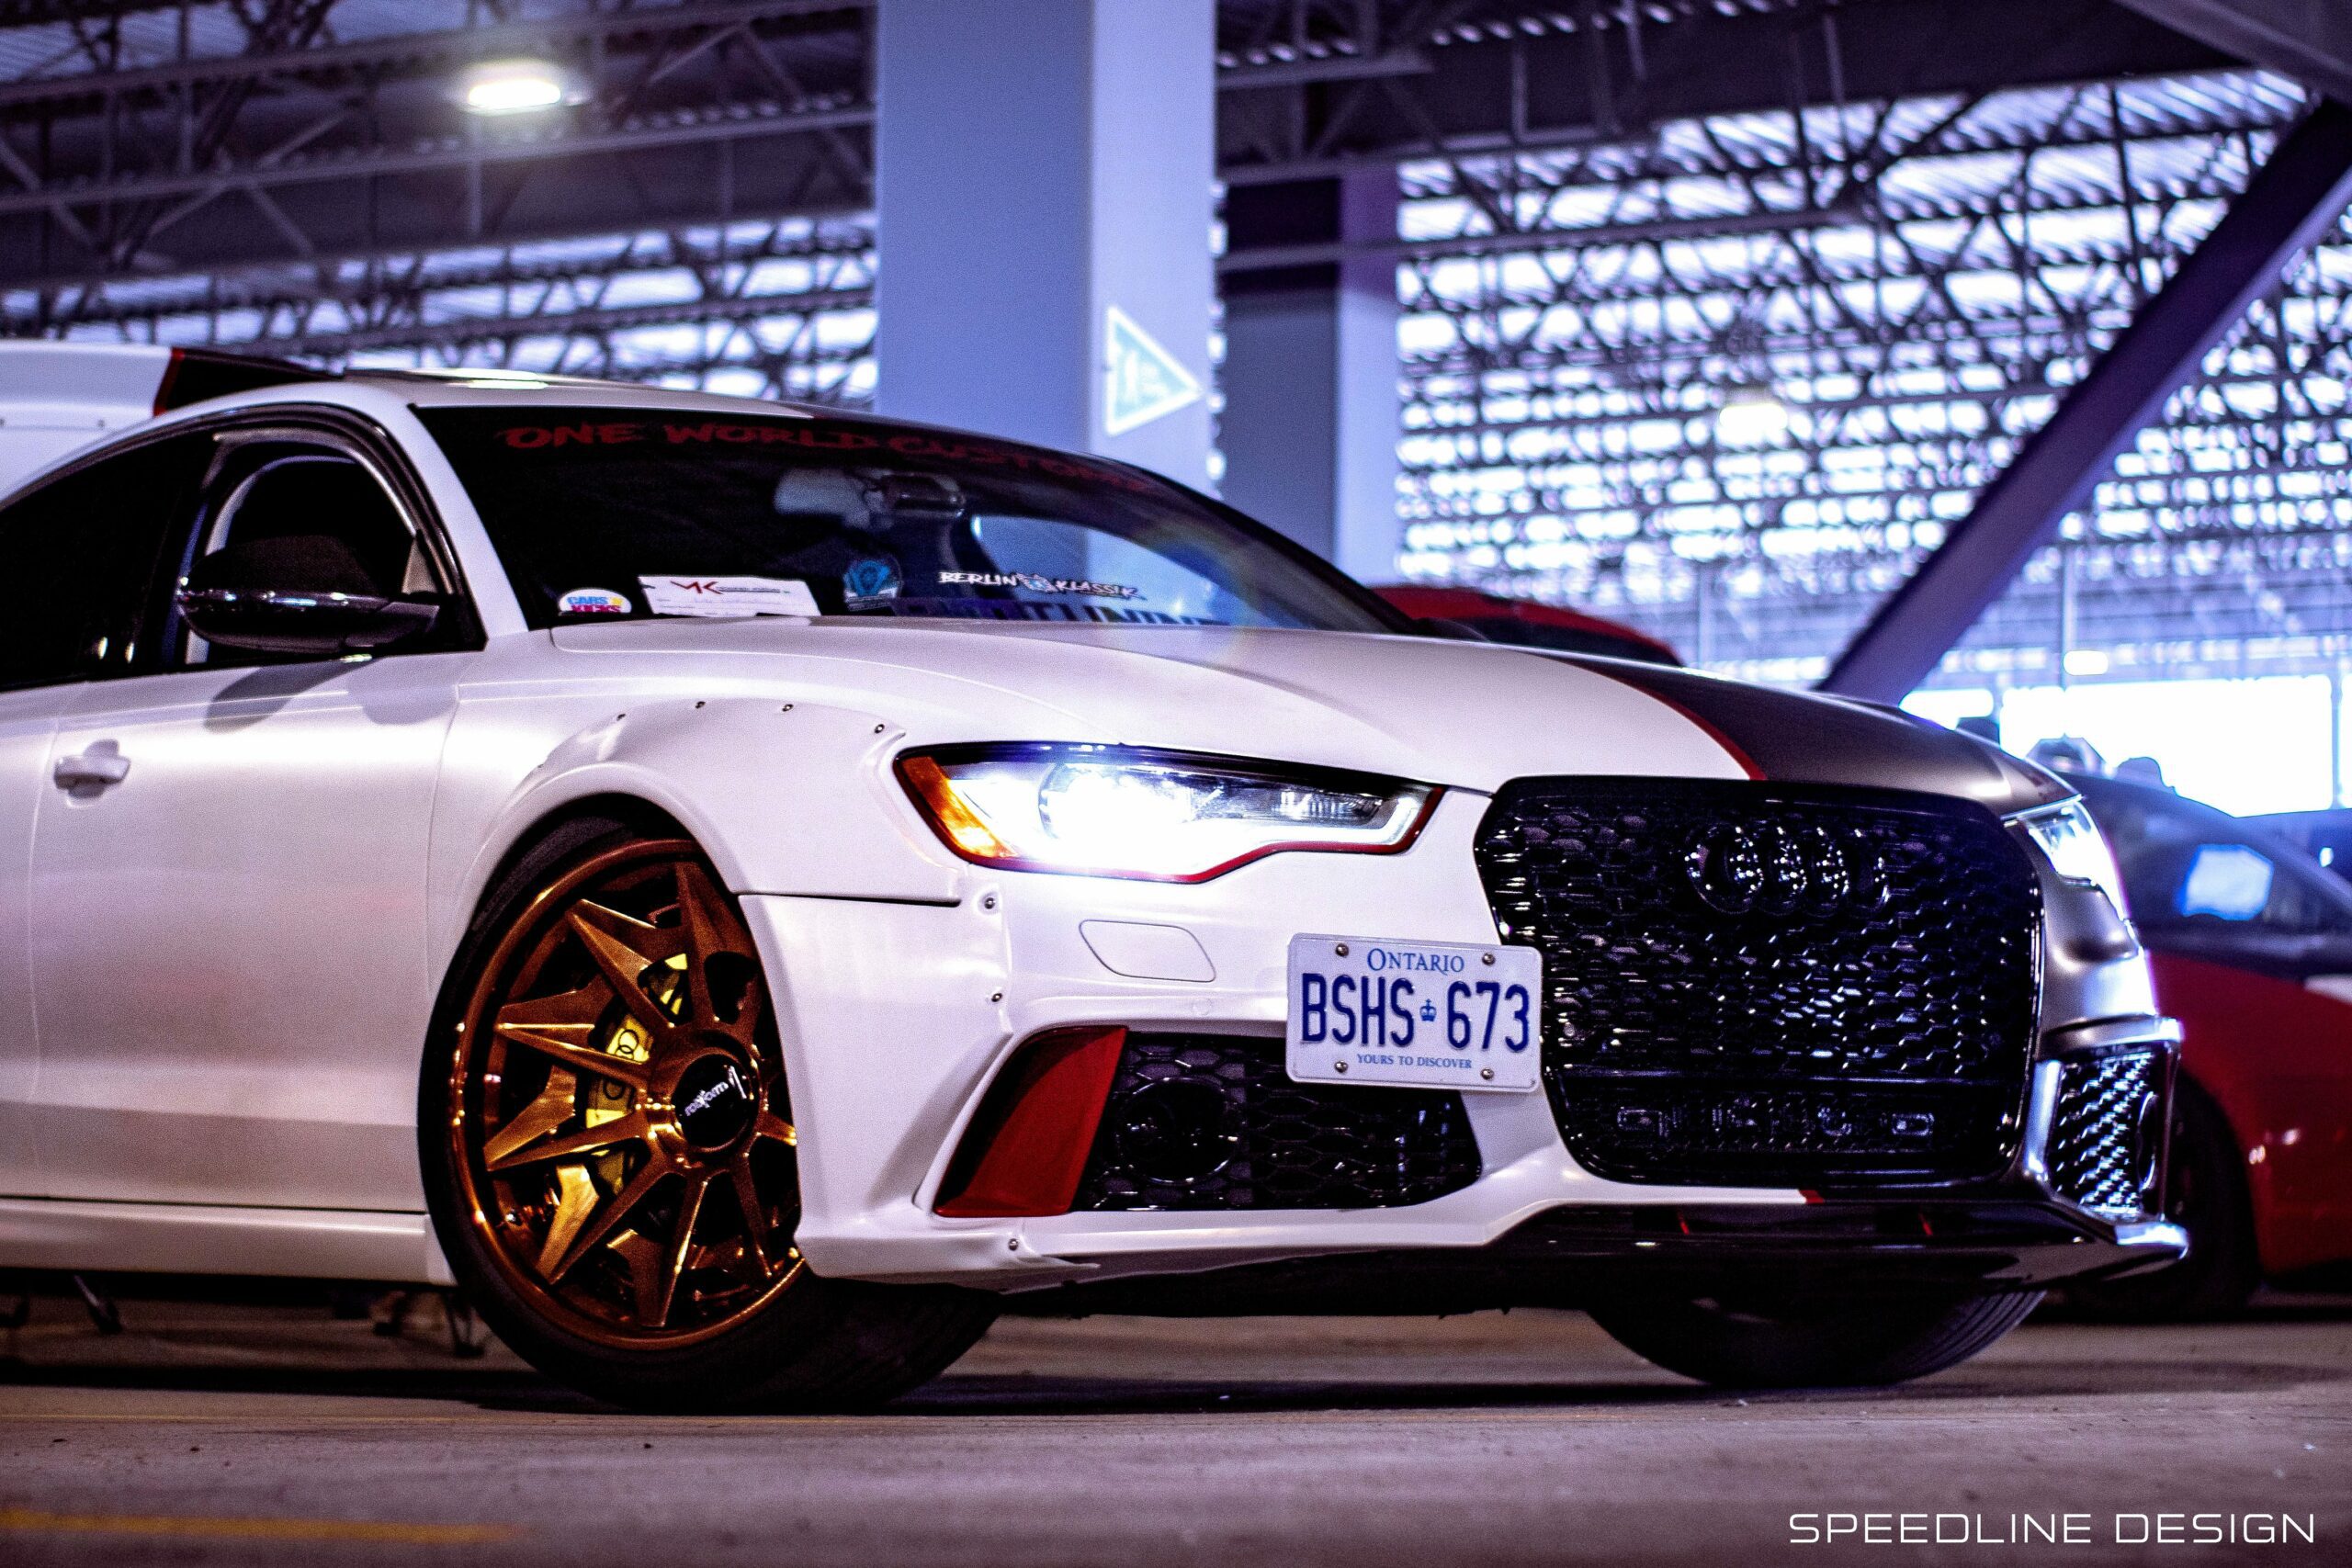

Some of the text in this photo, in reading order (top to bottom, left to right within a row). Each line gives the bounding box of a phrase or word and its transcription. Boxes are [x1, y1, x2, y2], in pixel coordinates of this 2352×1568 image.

[496, 422, 641, 448] ONE
[662, 423, 878, 450] WORLD
[937, 571, 1142, 599] BERLIN KLASSIK
[567, 596, 608, 605] CARS
[1366, 948, 1465, 976] ONTARIO
[1301, 972, 1531, 1054] BSHS 673
[1357, 1054, 1472, 1069] YOURS TO DISCOVER
